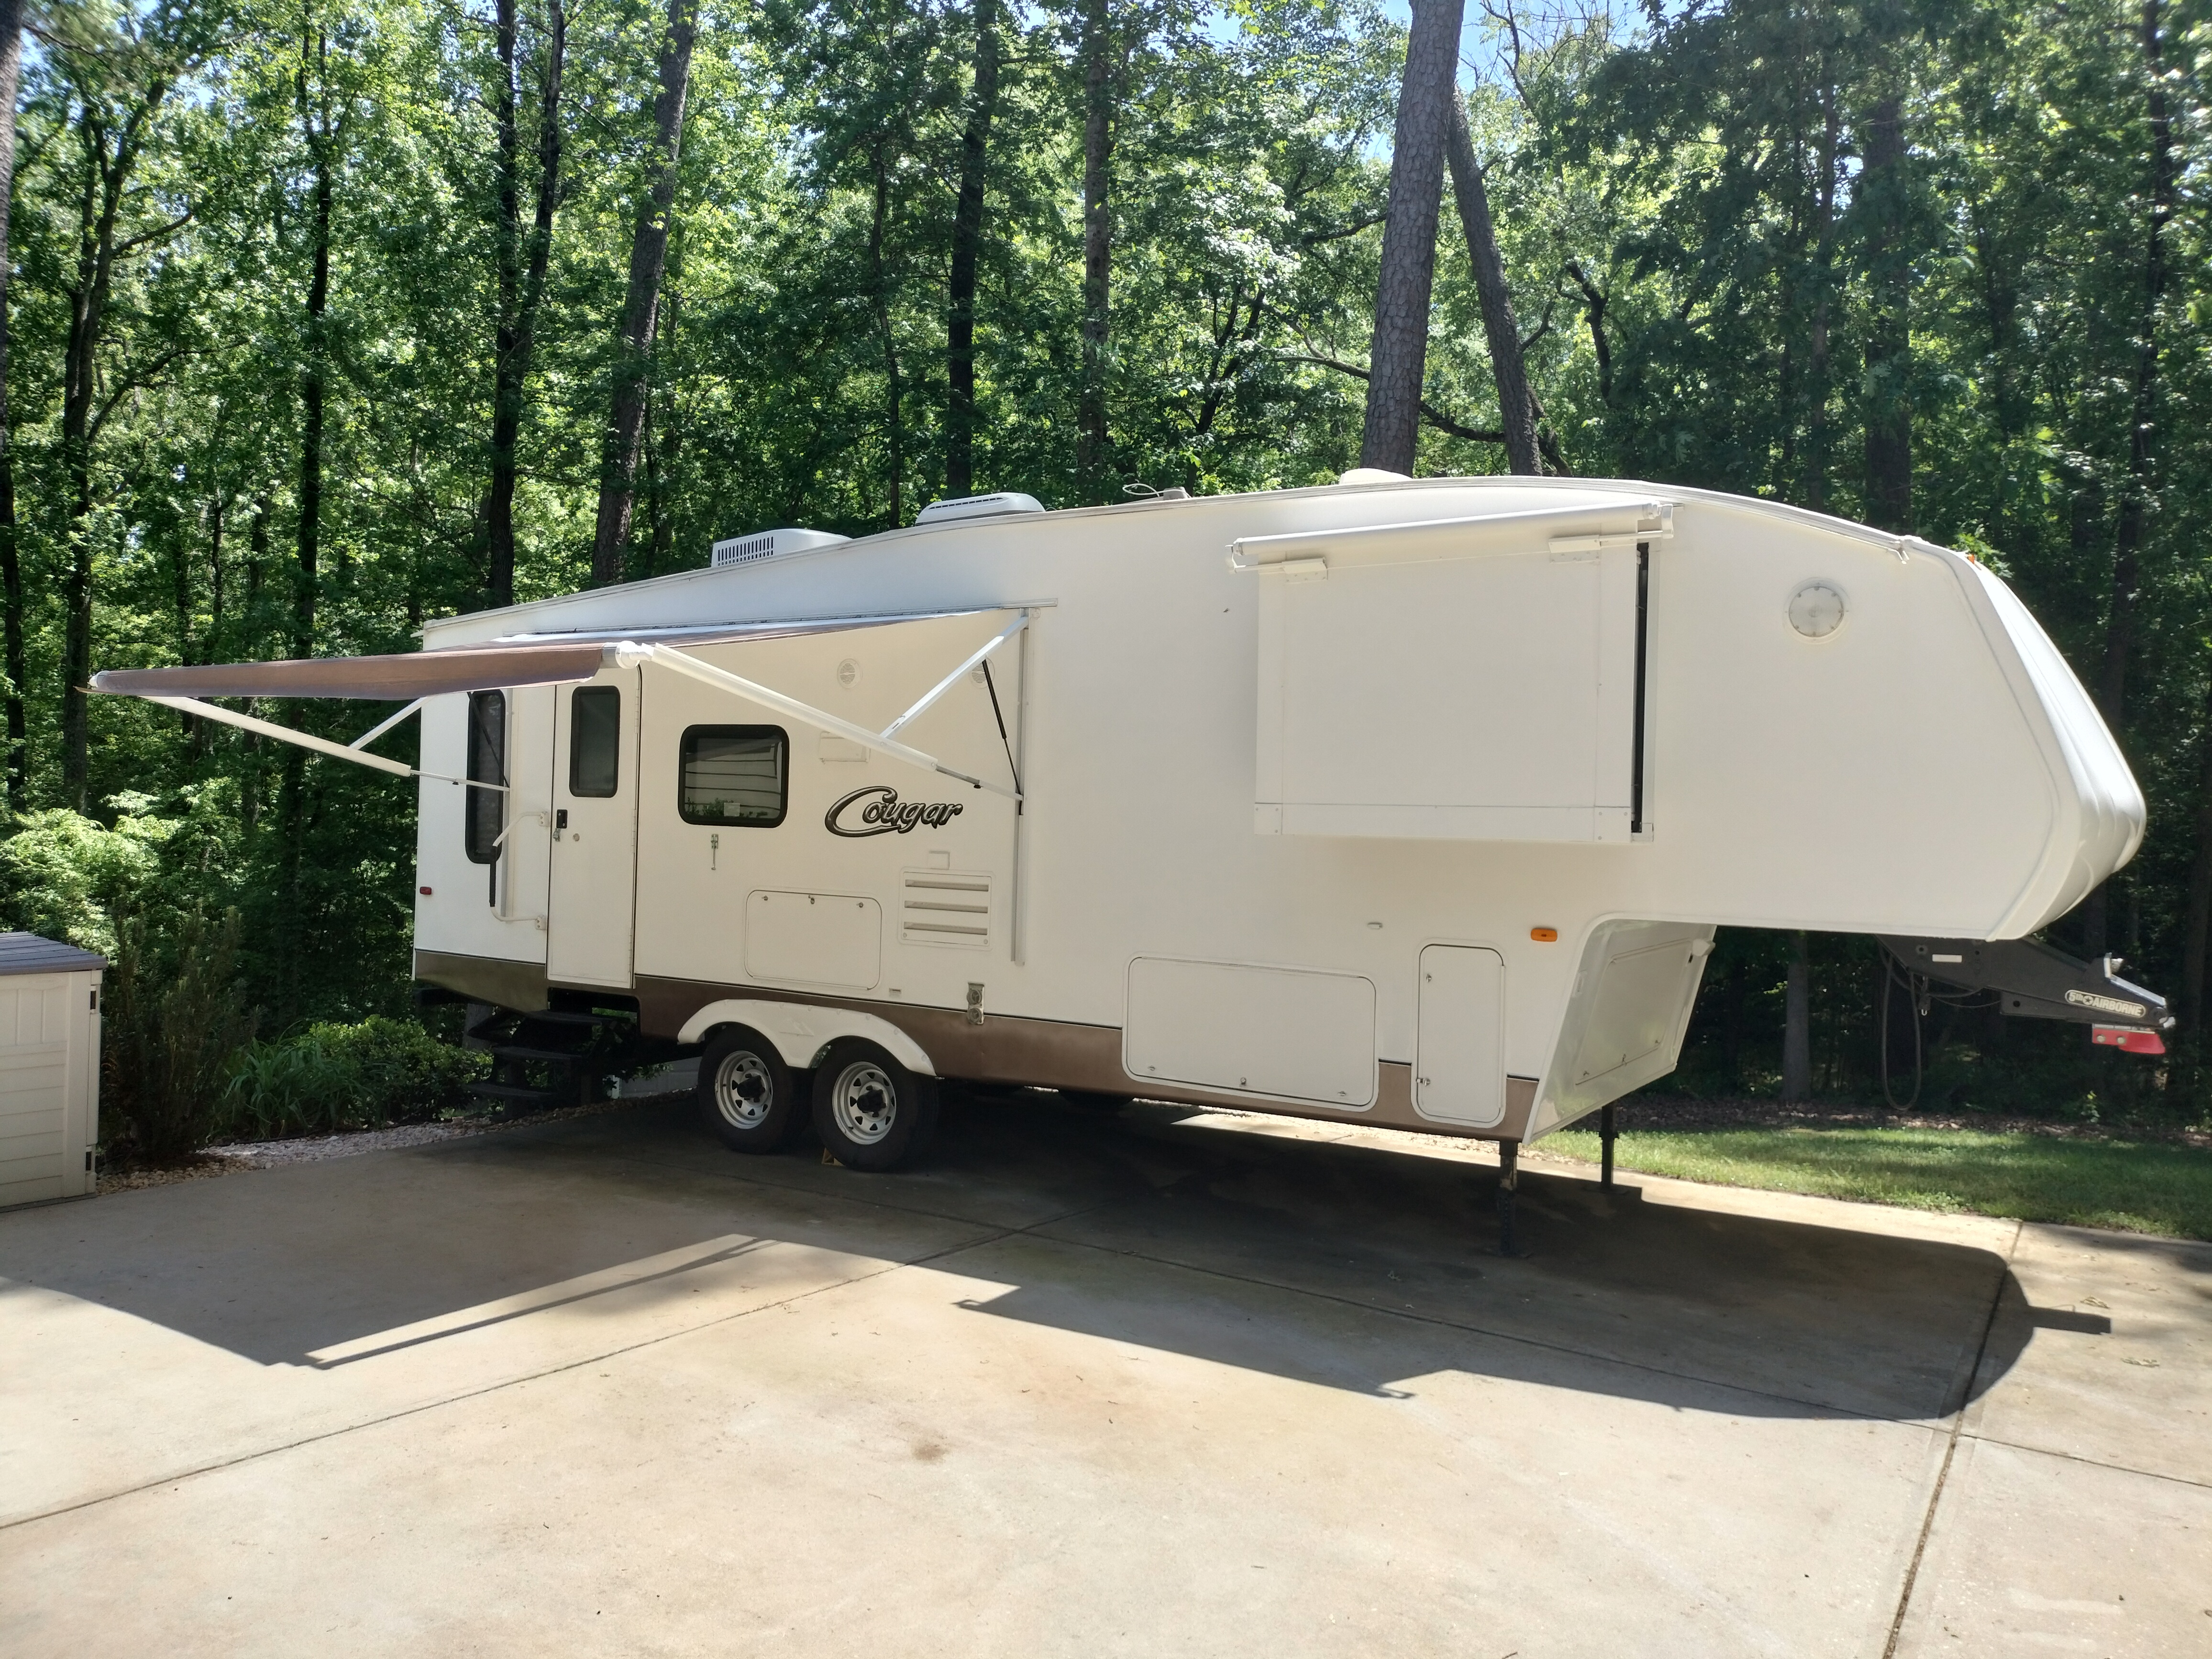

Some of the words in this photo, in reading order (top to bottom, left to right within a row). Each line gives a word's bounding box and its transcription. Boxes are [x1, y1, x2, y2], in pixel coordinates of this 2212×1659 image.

[825, 786, 963, 837] Cougar
[2069, 992, 2083, 1002] 5th
[2092, 998, 2142, 1016] AIRBORNE
